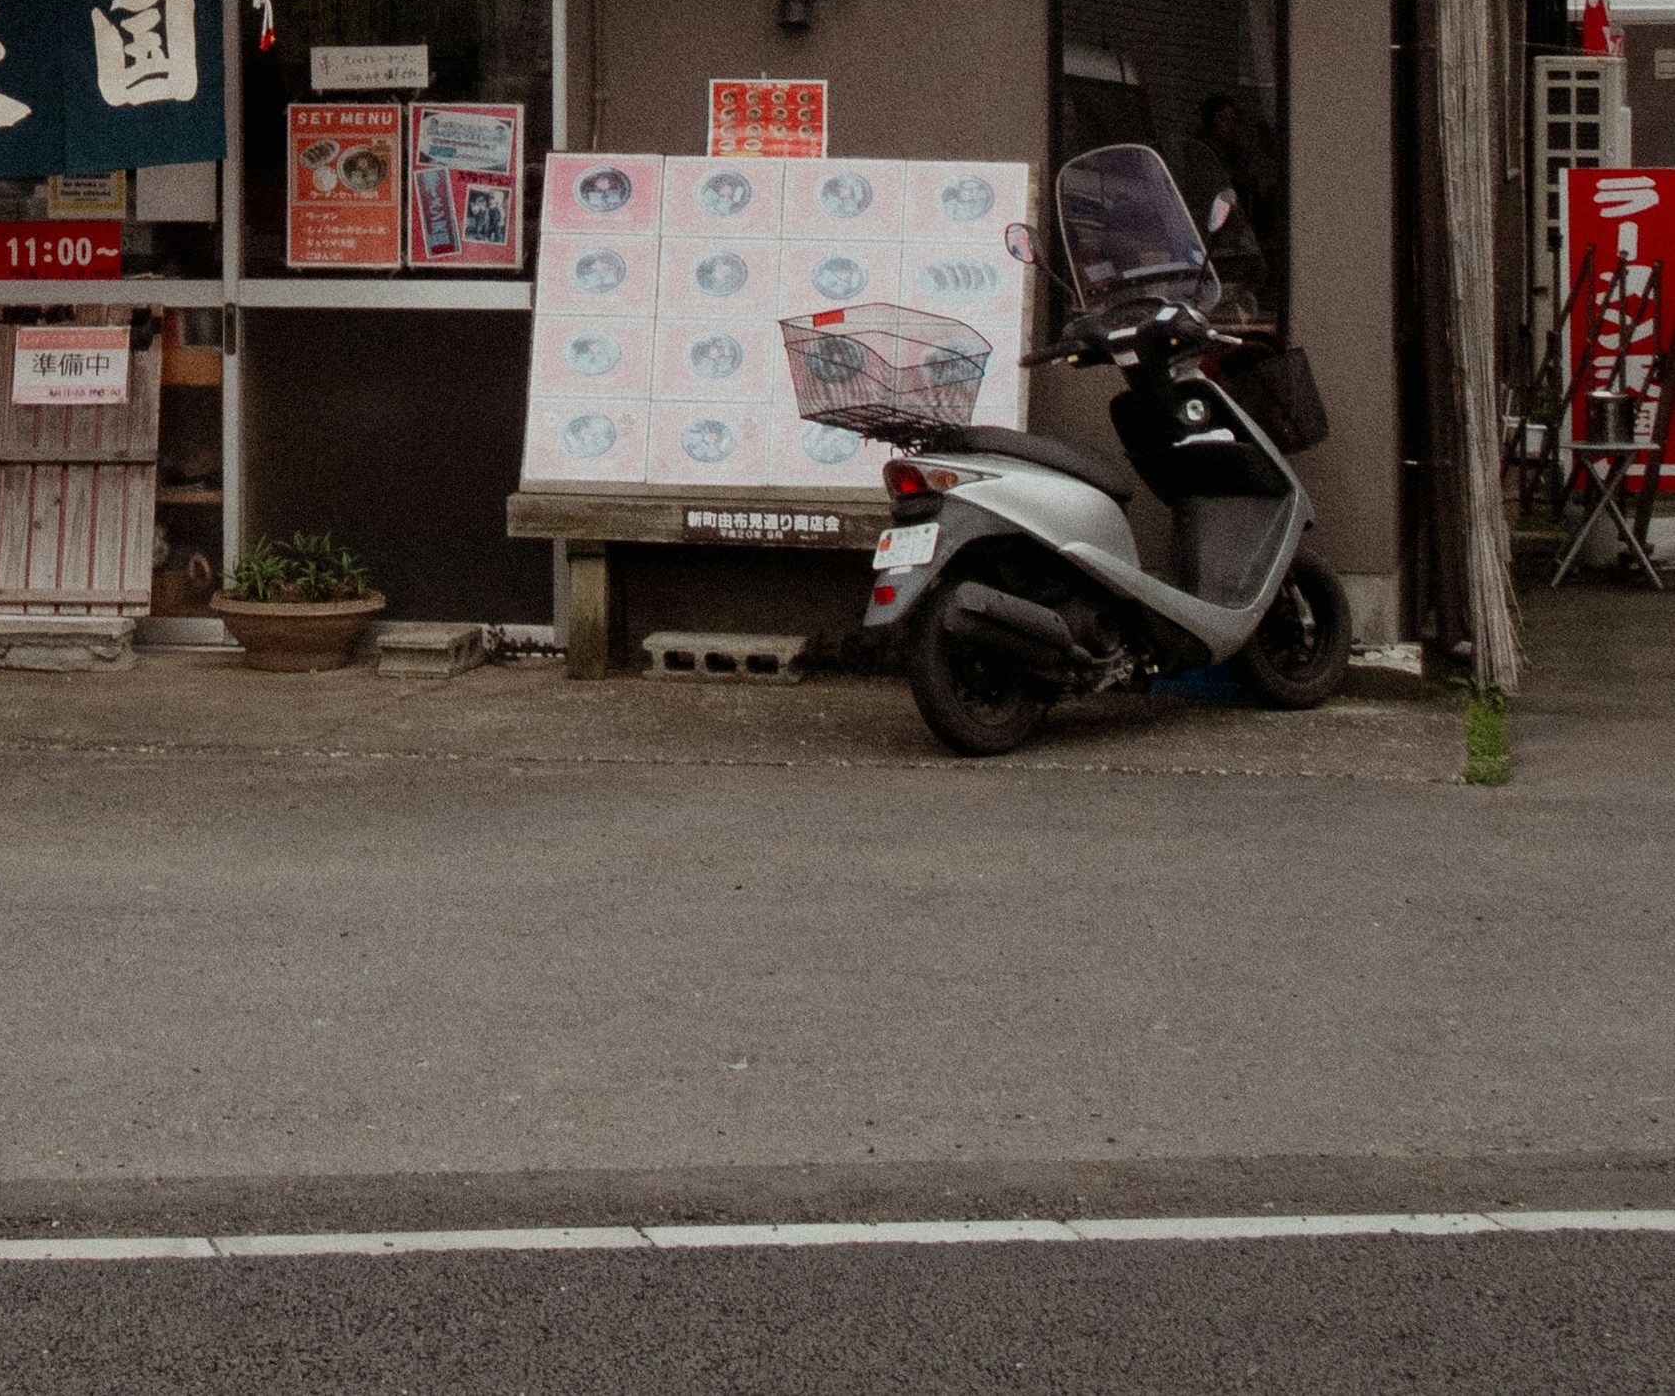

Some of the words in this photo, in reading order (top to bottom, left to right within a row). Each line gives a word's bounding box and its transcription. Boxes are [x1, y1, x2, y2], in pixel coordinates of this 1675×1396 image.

[297, 111, 335, 125] SET
[339, 111, 393, 125] MENU
[32, 352, 110, 377] 準備中
